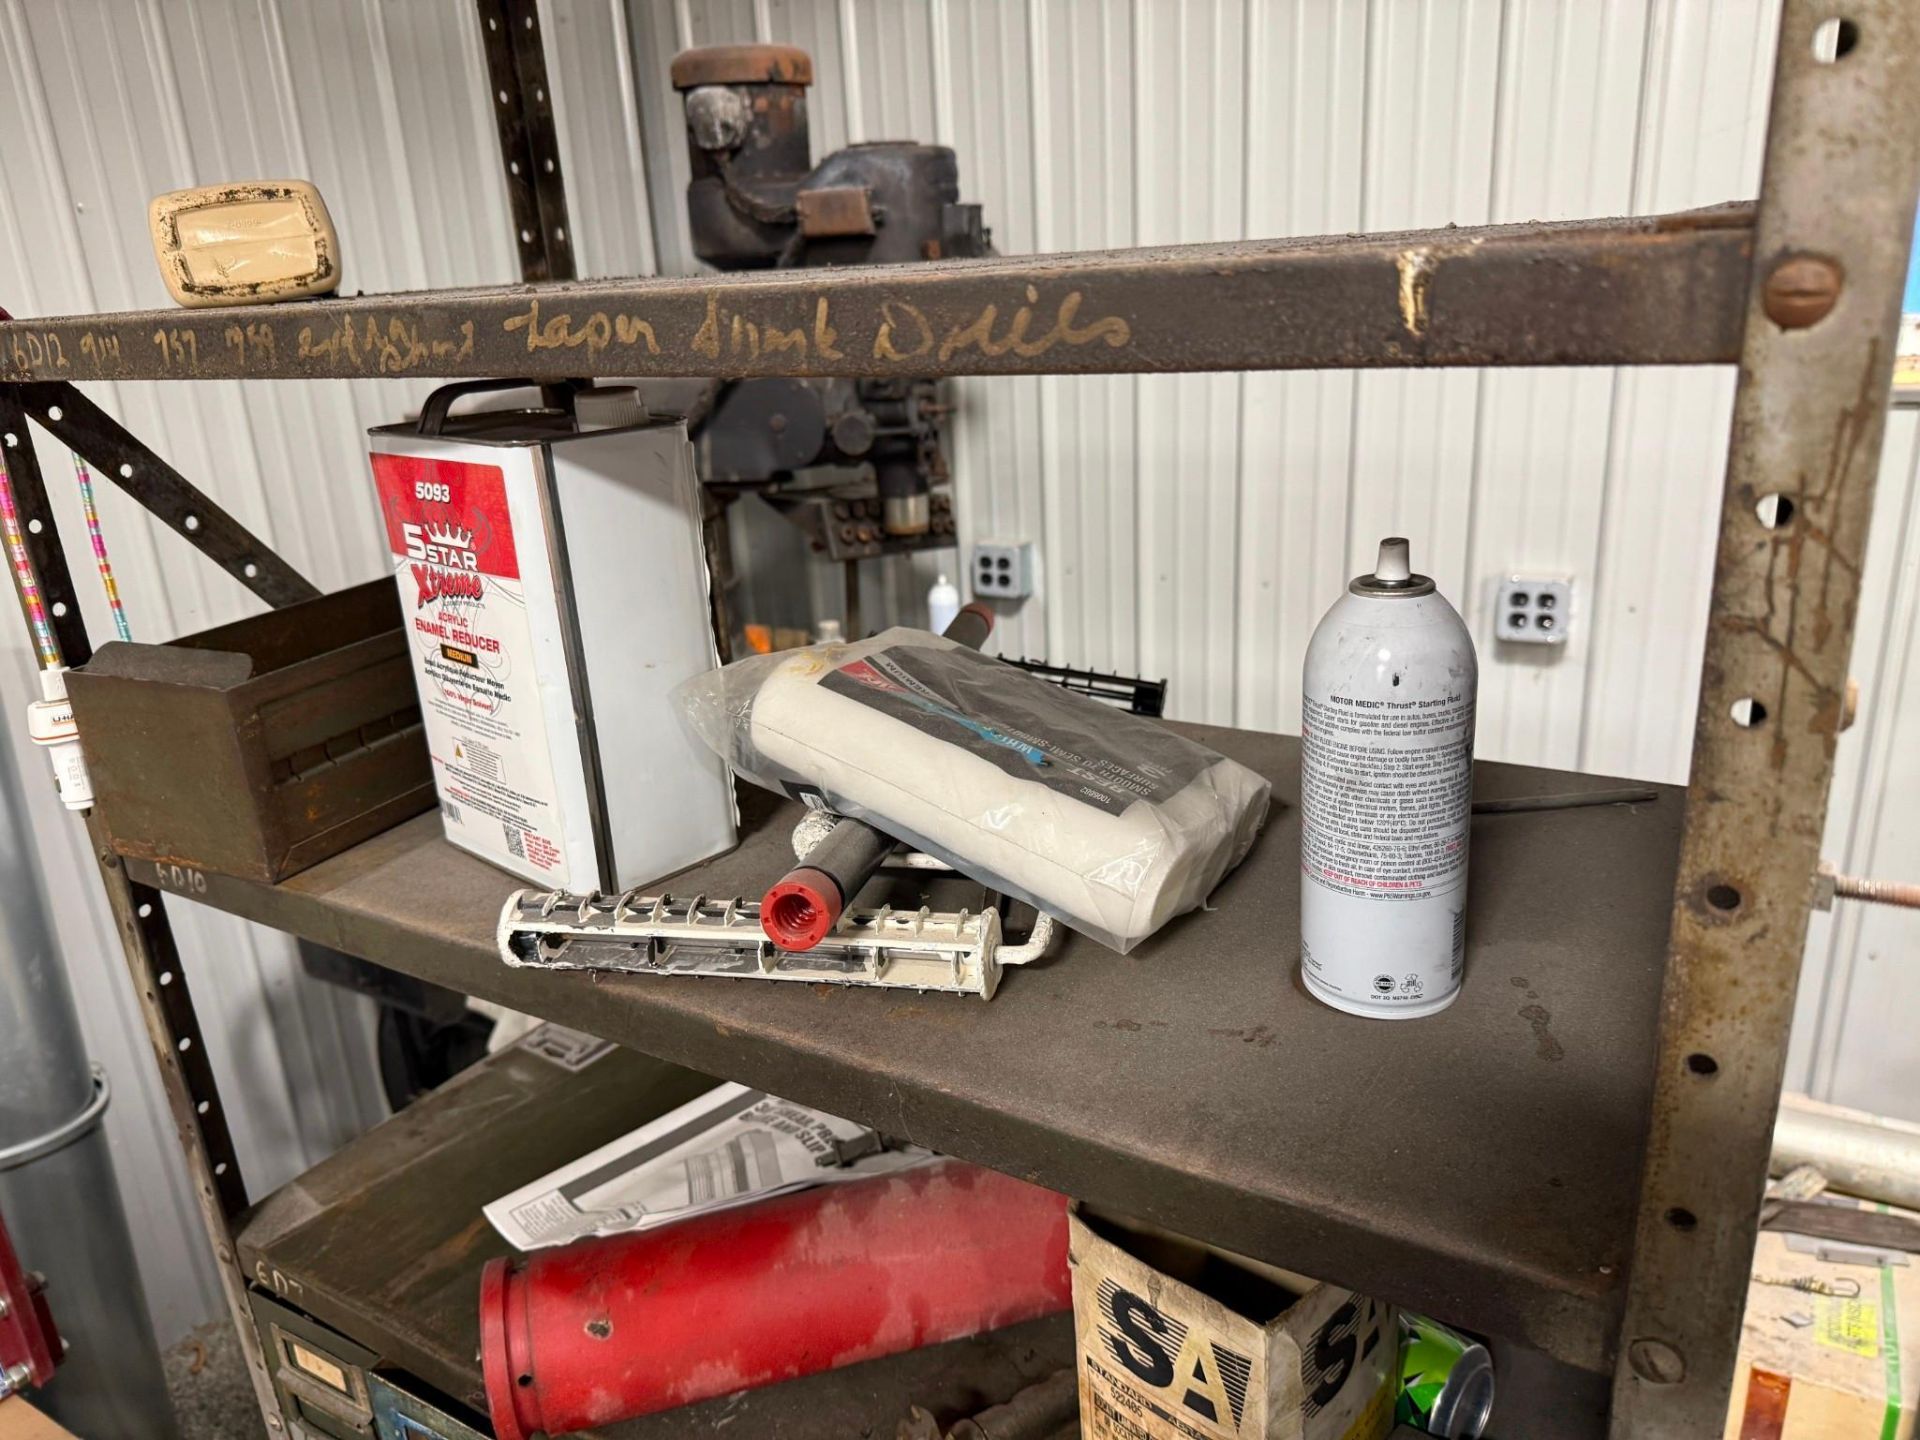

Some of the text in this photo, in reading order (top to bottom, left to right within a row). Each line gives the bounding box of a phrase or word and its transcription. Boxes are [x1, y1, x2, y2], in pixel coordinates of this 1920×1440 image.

[415, 482, 450, 503] 5093
[410, 563, 484, 609] Xtreme
[438, 612, 469, 628] ACRYLIC
[415, 617, 500, 654] ENAMEL REDUCER
[447, 648, 472, 663] MEDIUM
[886, 662, 932, 696] REMIUM
[1330, 695, 1354, 706] MOTOR
[1387, 701, 1416, 709] Thrust®
[1418, 699, 1446, 709] Starting
[1447, 694, 1461, 703] Fluid
[1082, 760, 1097, 771] TO
[1098, 759, 1159, 790] SURFACES
[1065, 766, 1126, 794] BEST
[1099, 769, 1152, 796] SMOOTH
[1334, 872, 1344, 880] OUT
[1350, 877, 1368, 886] REACH
[795, 1129, 827, 1153] SLIP
